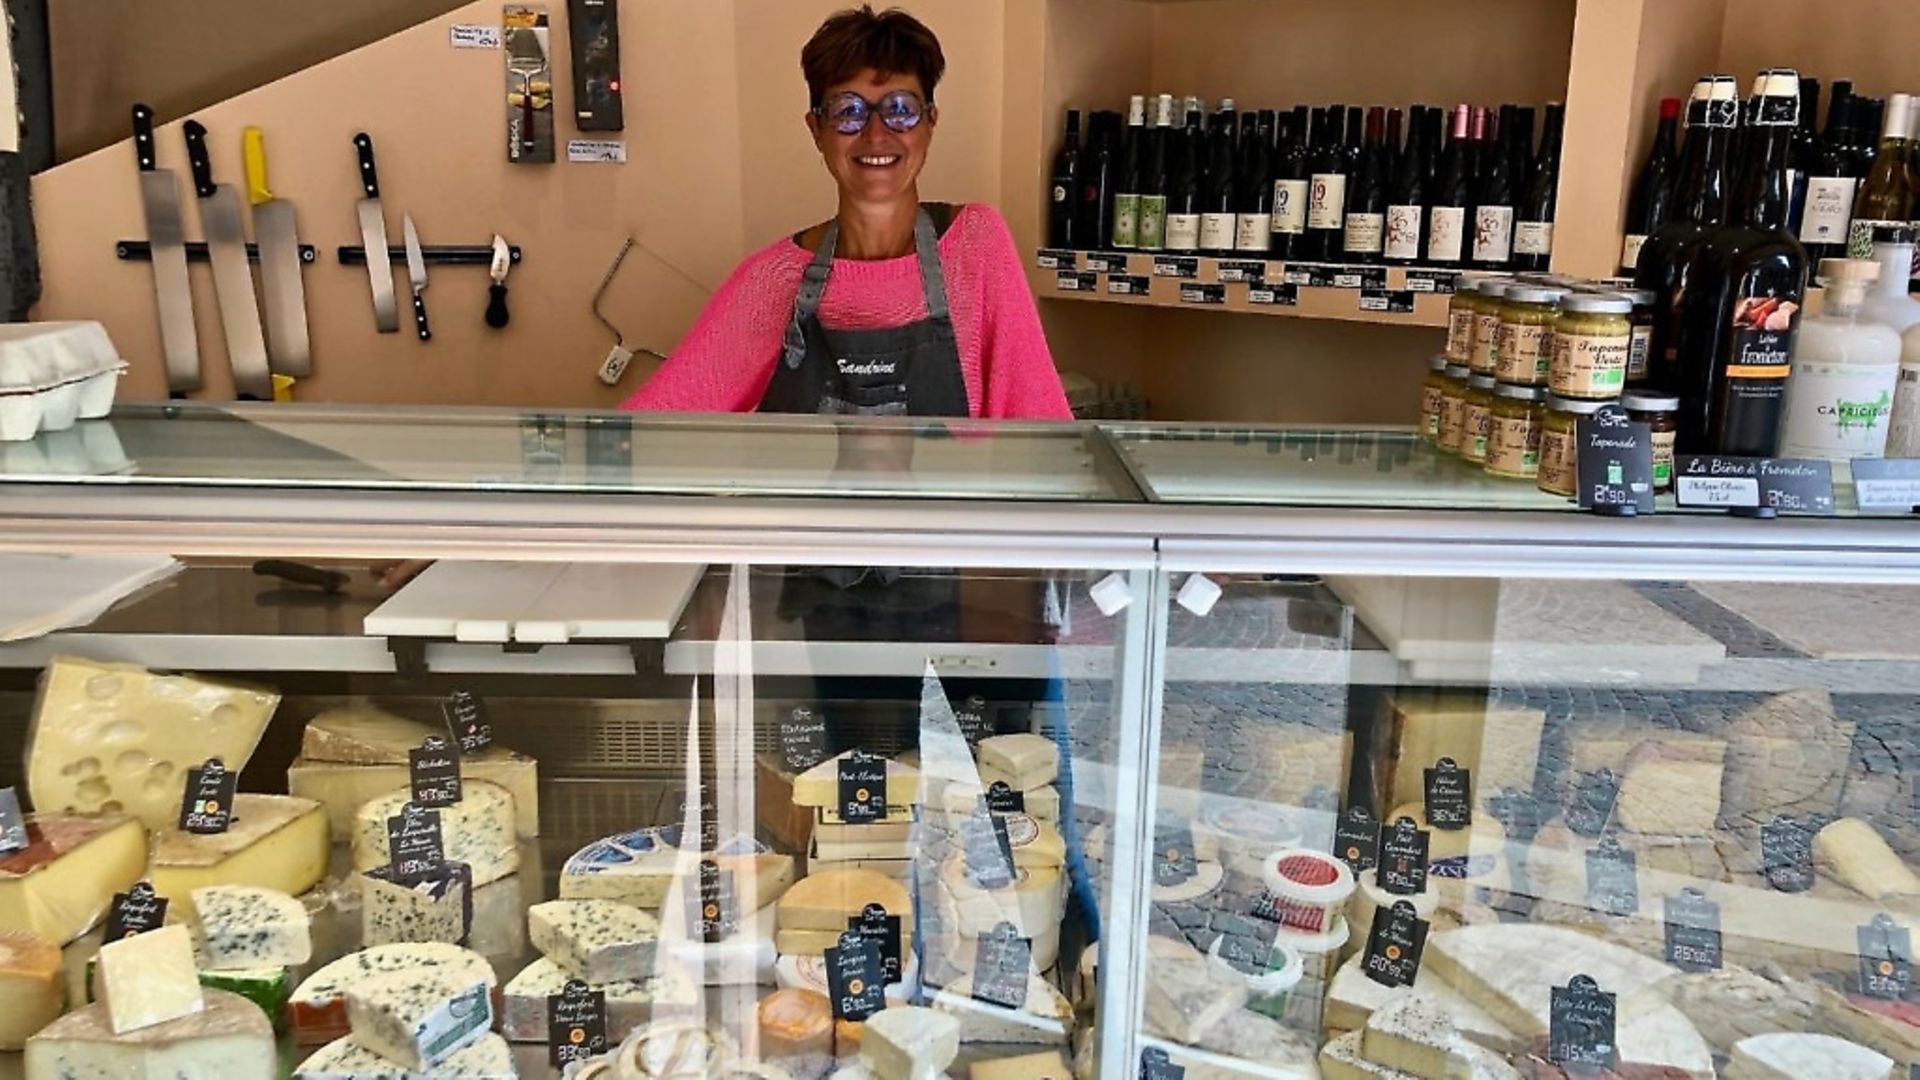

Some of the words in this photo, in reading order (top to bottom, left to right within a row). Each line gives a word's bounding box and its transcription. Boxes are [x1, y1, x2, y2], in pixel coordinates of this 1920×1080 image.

[836, 359, 896, 376] Sandrine
[1590, 433, 1637, 450] Tapenade
[1687, 458, 1706, 473] La
[1710, 458, 1744, 474] Bière
